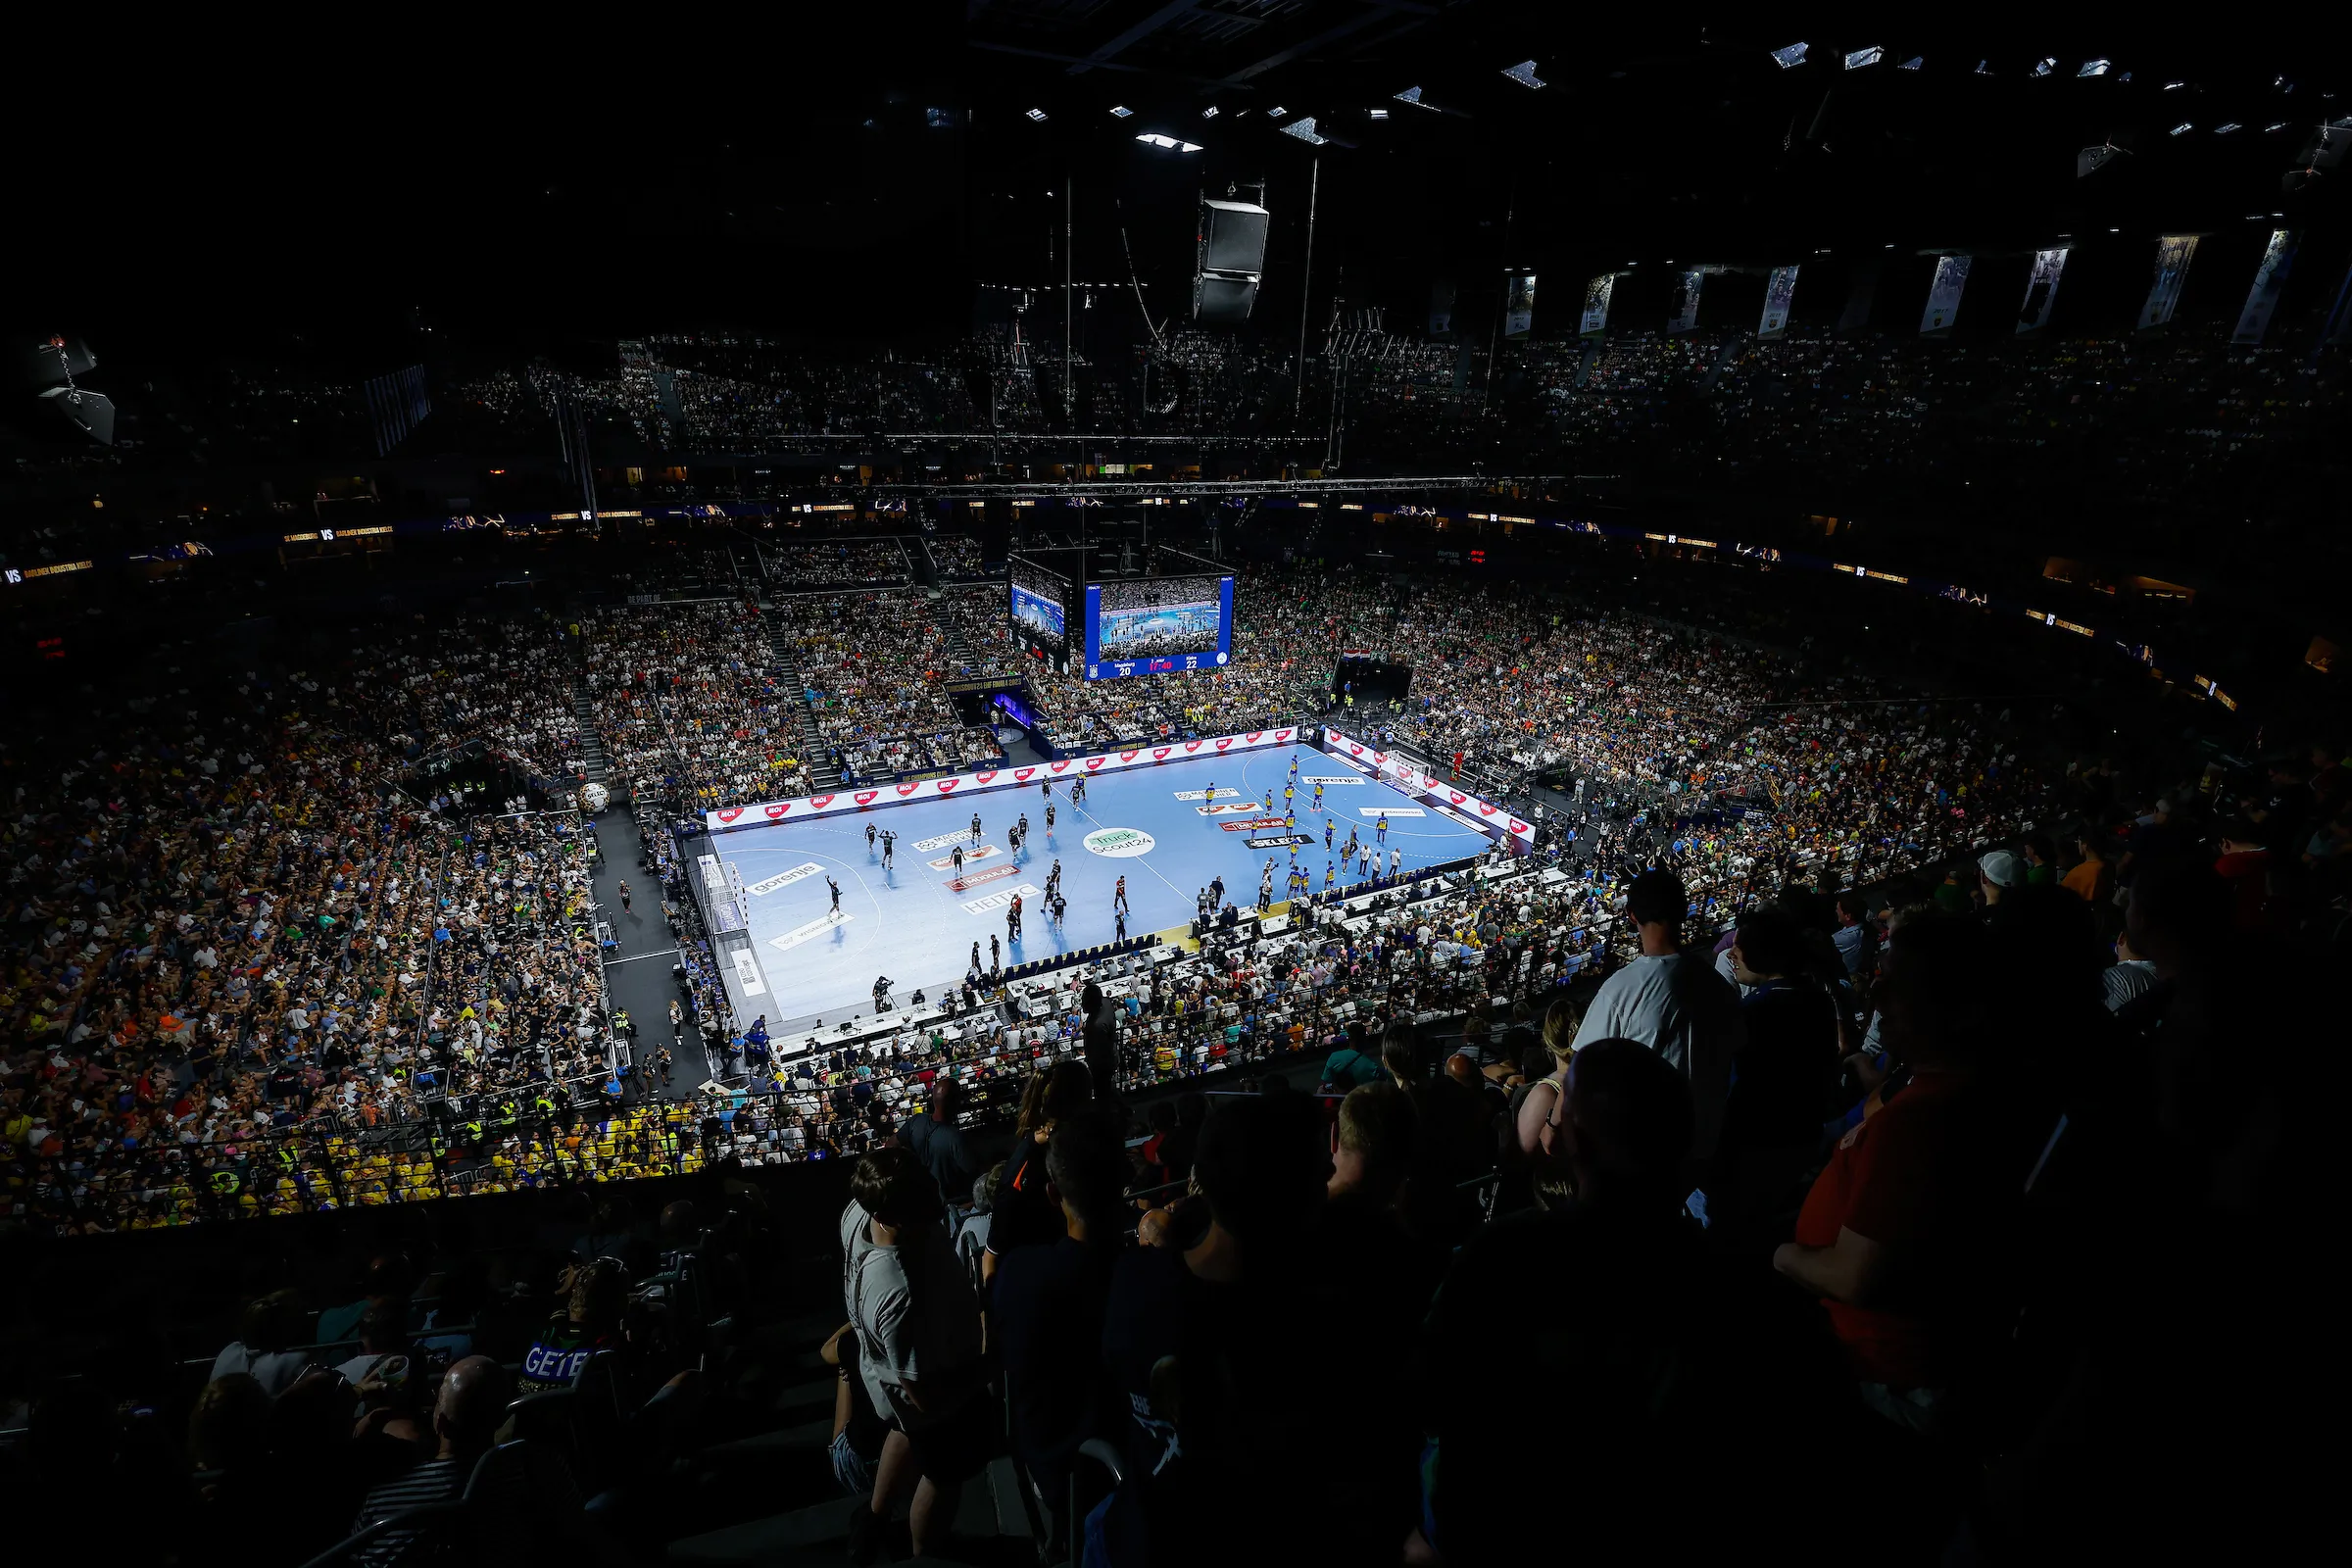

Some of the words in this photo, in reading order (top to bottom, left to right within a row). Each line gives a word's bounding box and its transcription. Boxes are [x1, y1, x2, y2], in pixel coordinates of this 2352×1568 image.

[320, 529, 333, 540] VS
[5, 568, 22, 583] VS
[1150, 662, 1172, 671] 17:40
[1186, 661, 1197, 669] 22
[1119, 667, 1131, 676] 20
[1097, 832, 1134, 844] Truck
[1093, 838, 1152, 854] Scout24
[755, 864, 815, 893] gorenje
[964, 885, 1037, 913] HEITEC
